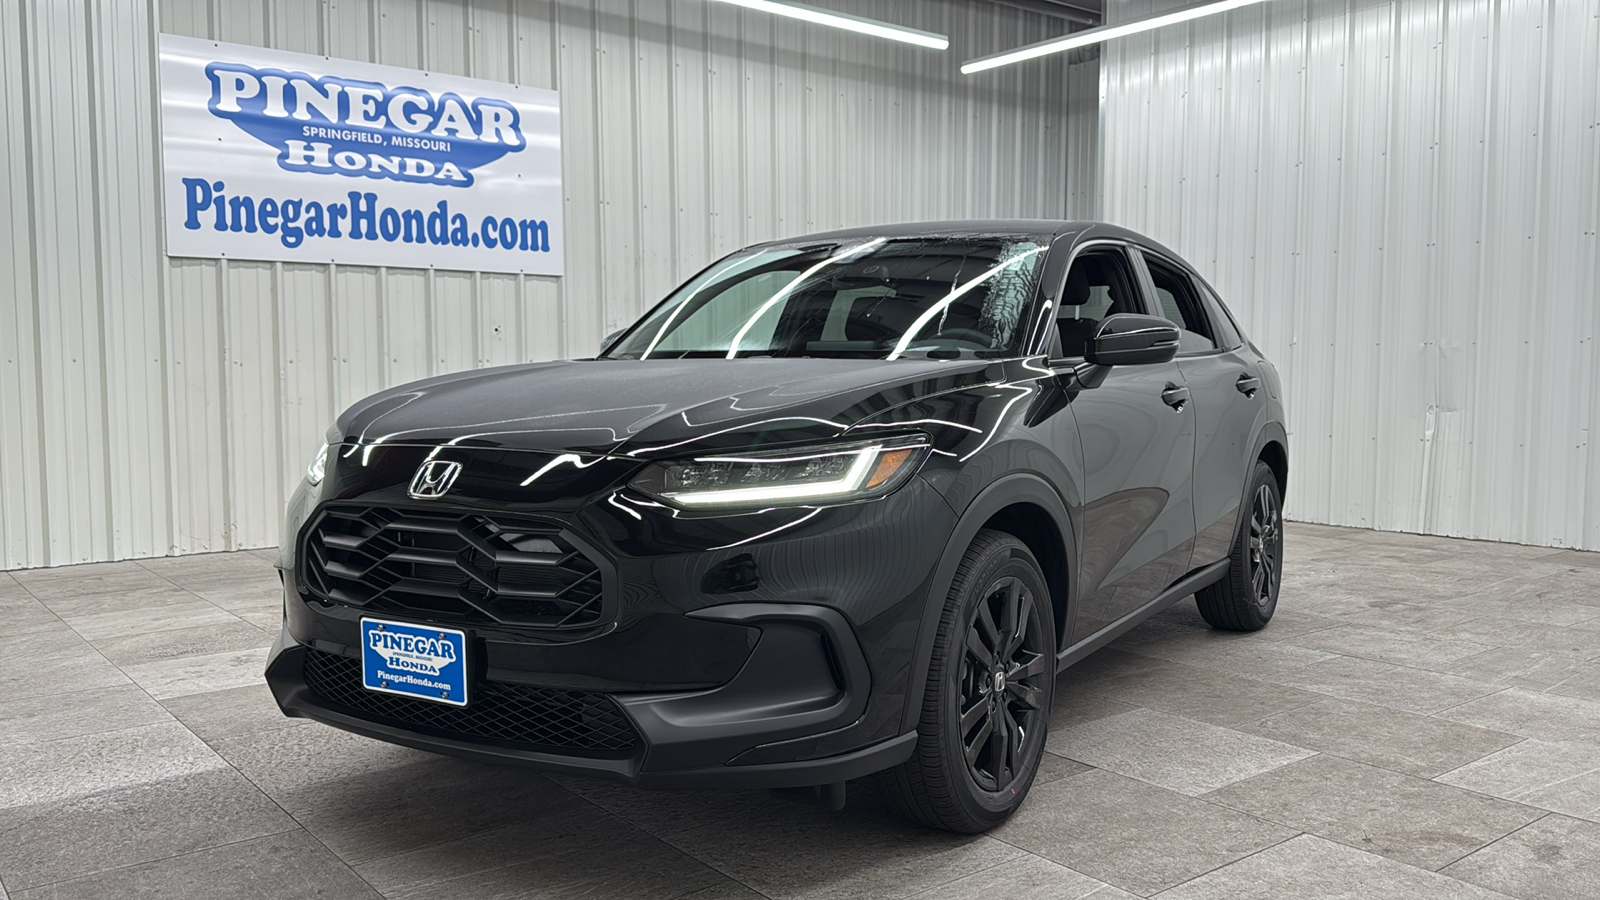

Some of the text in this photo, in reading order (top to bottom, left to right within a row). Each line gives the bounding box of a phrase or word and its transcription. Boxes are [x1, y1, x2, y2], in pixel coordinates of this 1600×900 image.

[213, 69, 521, 146] PINEGAR
[302, 125, 451, 153] SPRINGFIELD, MISSOURI
[284, 139, 468, 181] HONDA
[182, 177, 550, 253] PinegarHonda.com
[370, 632, 454, 660] PINEGAR
[388, 656, 438, 673] HONDA
[377, 670, 451, 691] PinegarHonda.com
